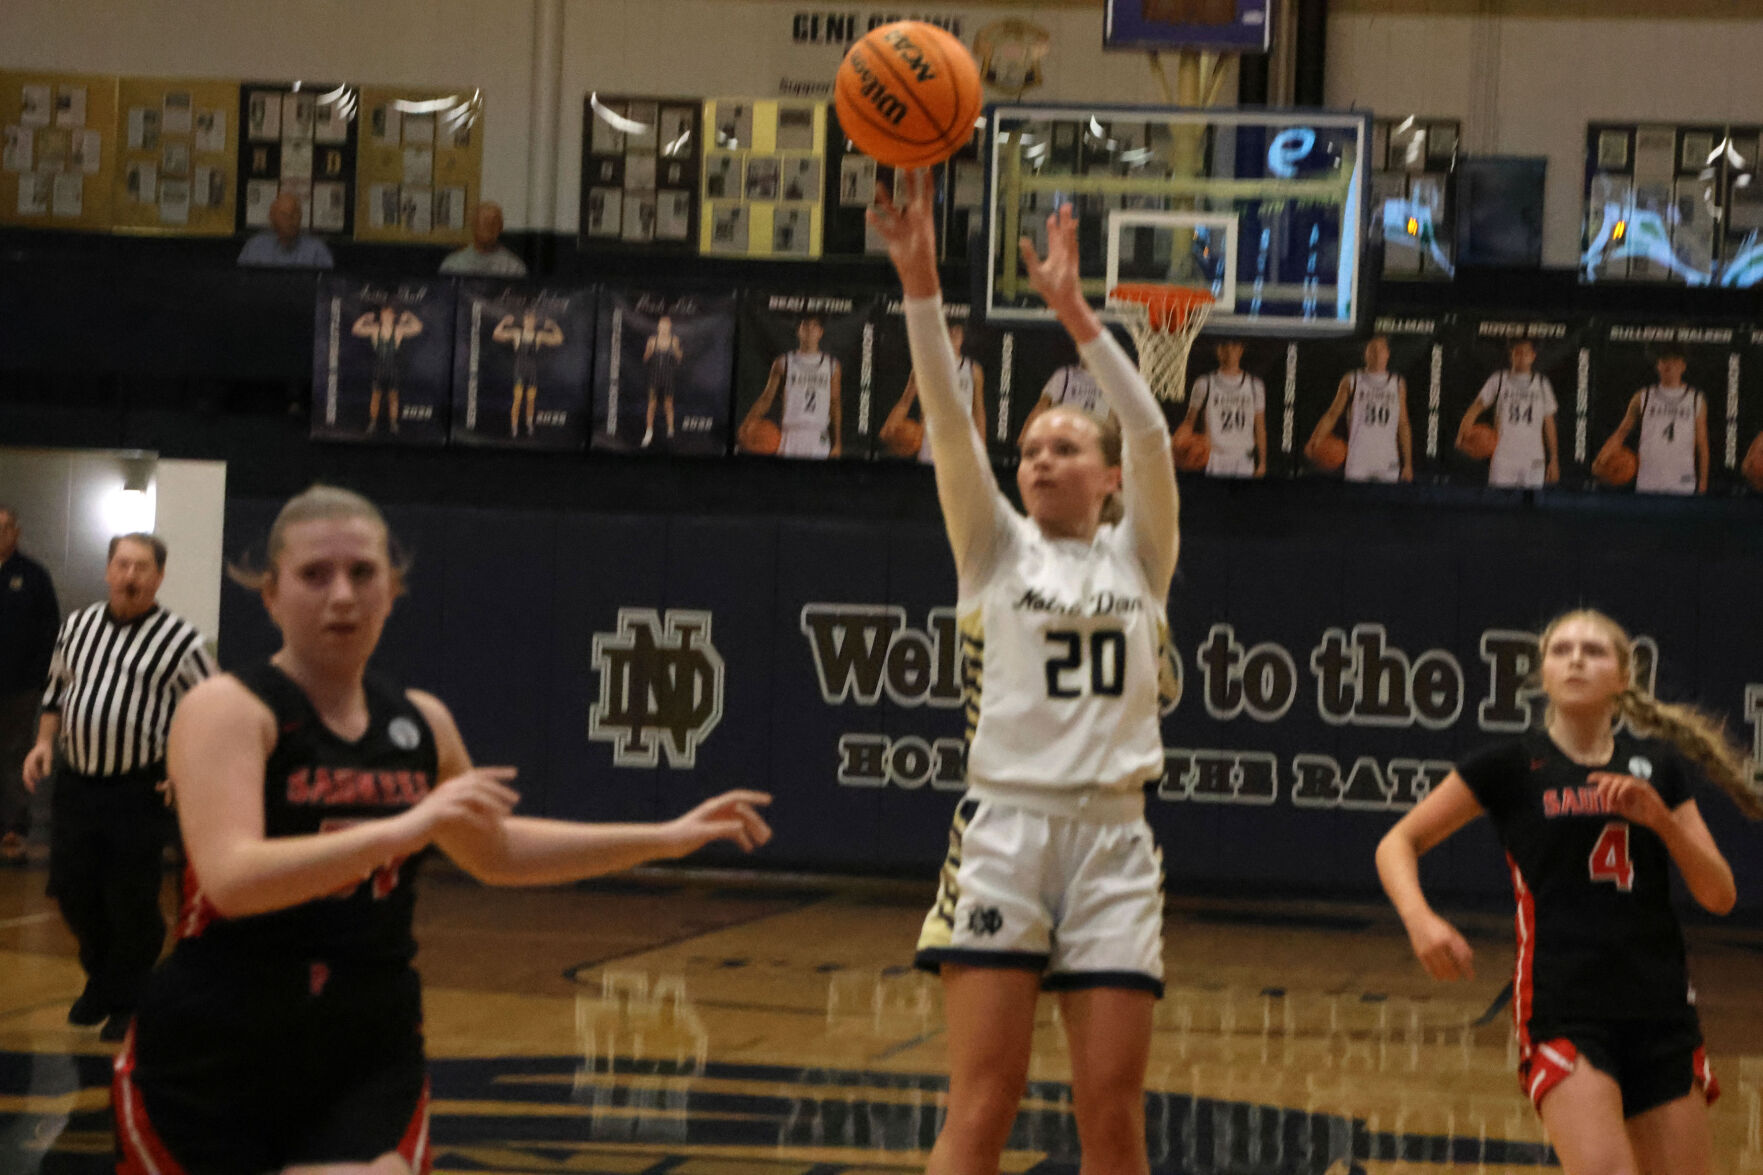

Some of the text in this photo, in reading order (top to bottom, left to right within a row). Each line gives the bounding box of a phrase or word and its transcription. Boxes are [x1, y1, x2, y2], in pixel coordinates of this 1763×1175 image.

[1046, 630, 1125, 698] 20
[1197, 621, 1297, 722] to
[1310, 622, 1464, 730] the
[1589, 821, 1634, 892] 4
